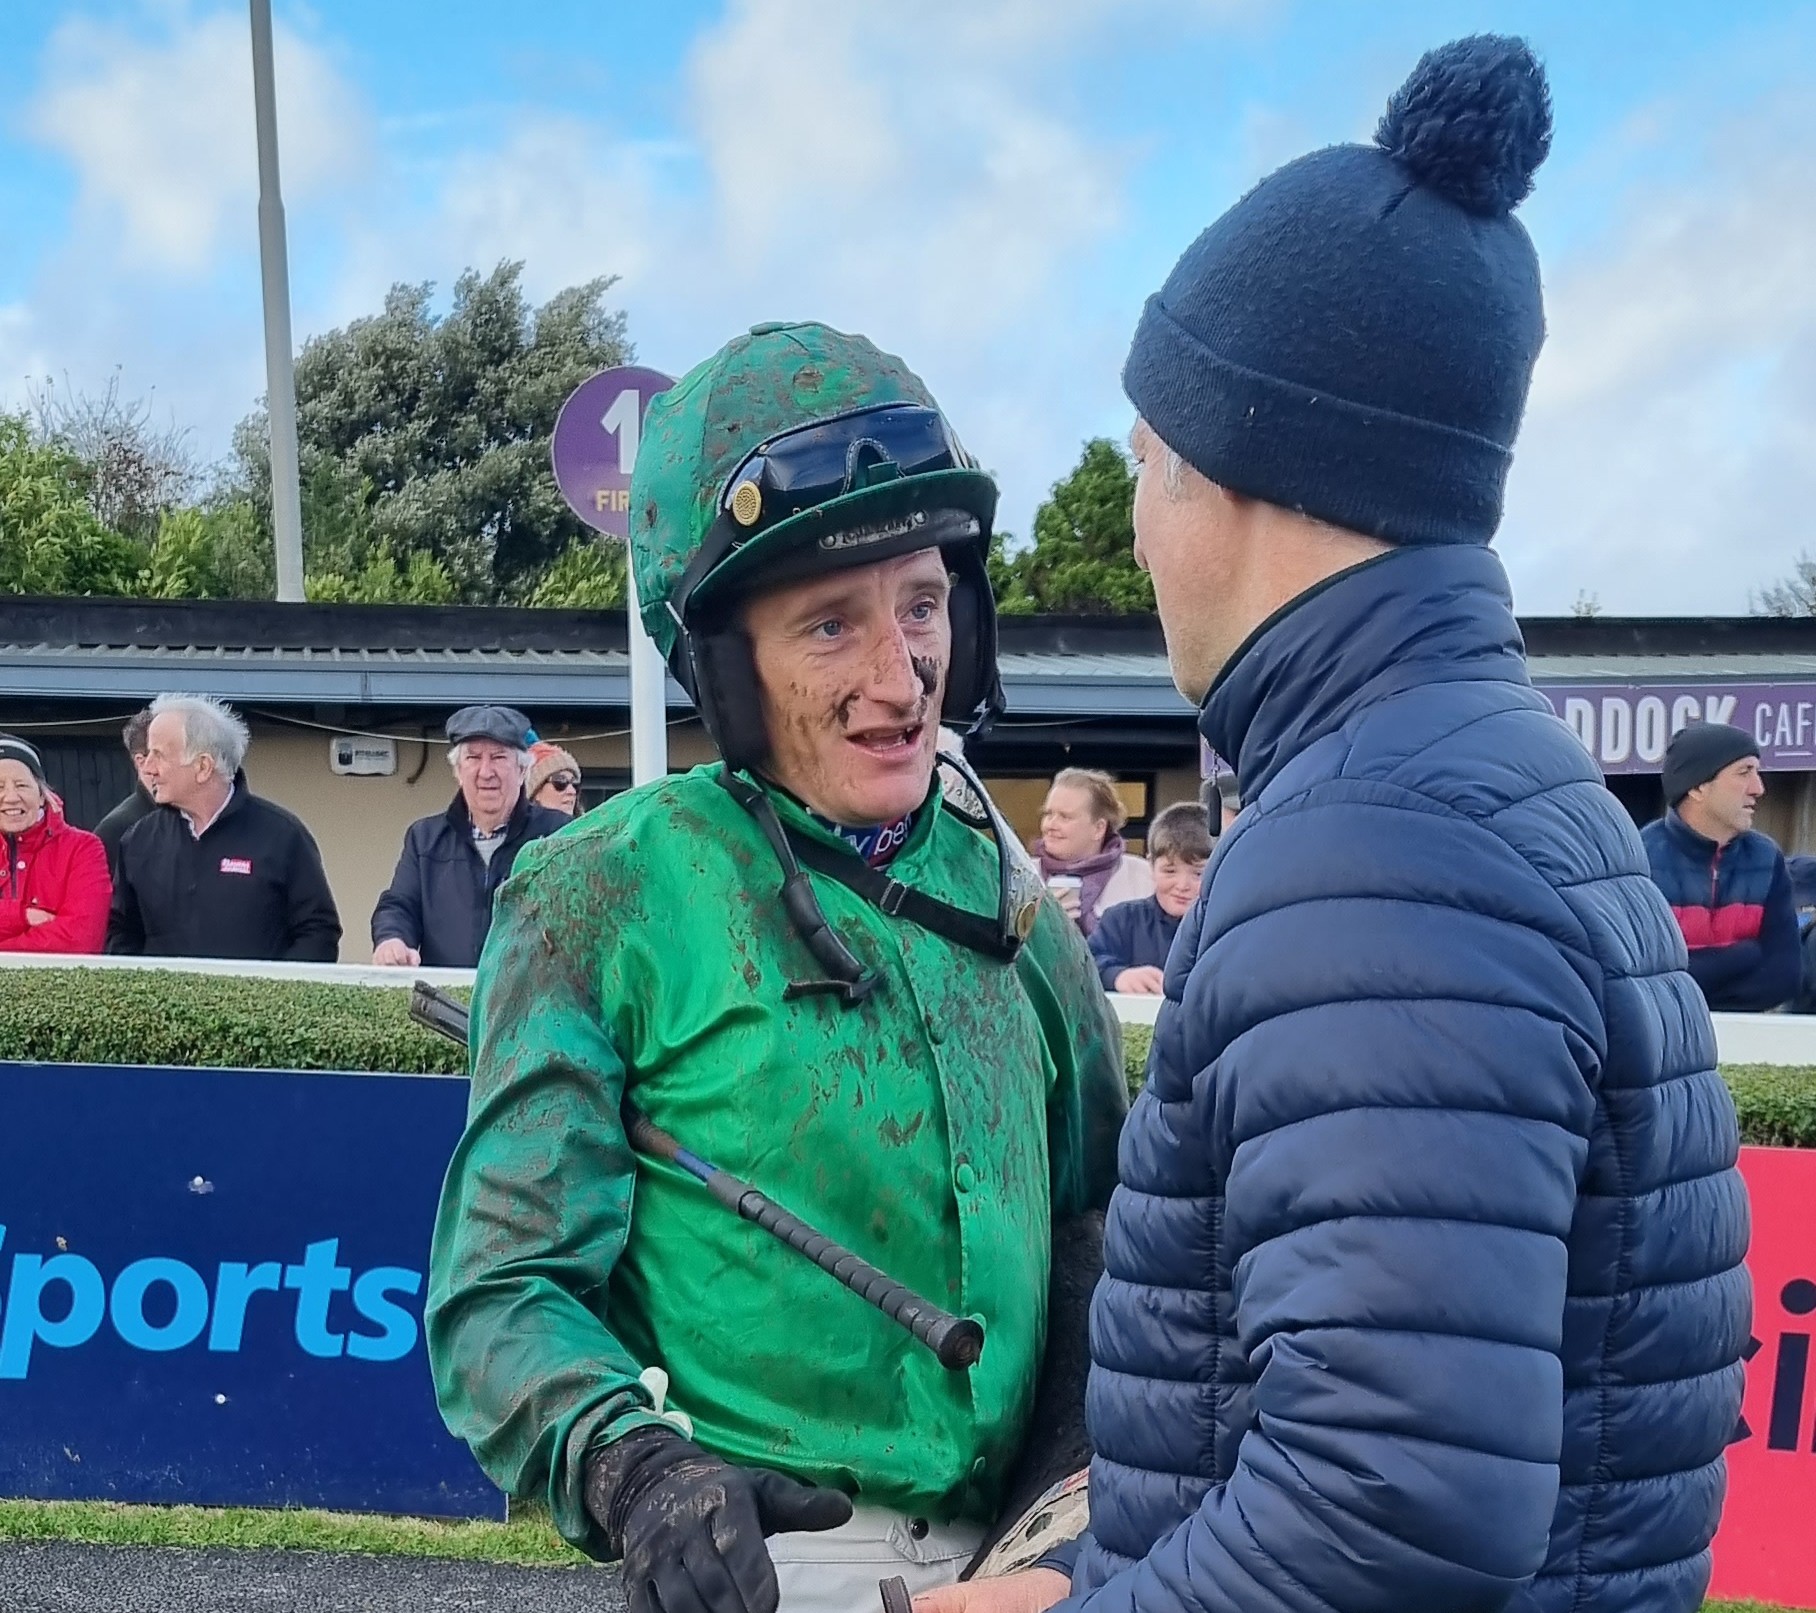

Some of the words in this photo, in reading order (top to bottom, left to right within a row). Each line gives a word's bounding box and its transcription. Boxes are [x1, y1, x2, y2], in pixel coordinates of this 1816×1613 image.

[601, 389, 640, 474] 1
[1755, 702, 1816, 747] CAF
[0, 1223, 422, 1380] ports
